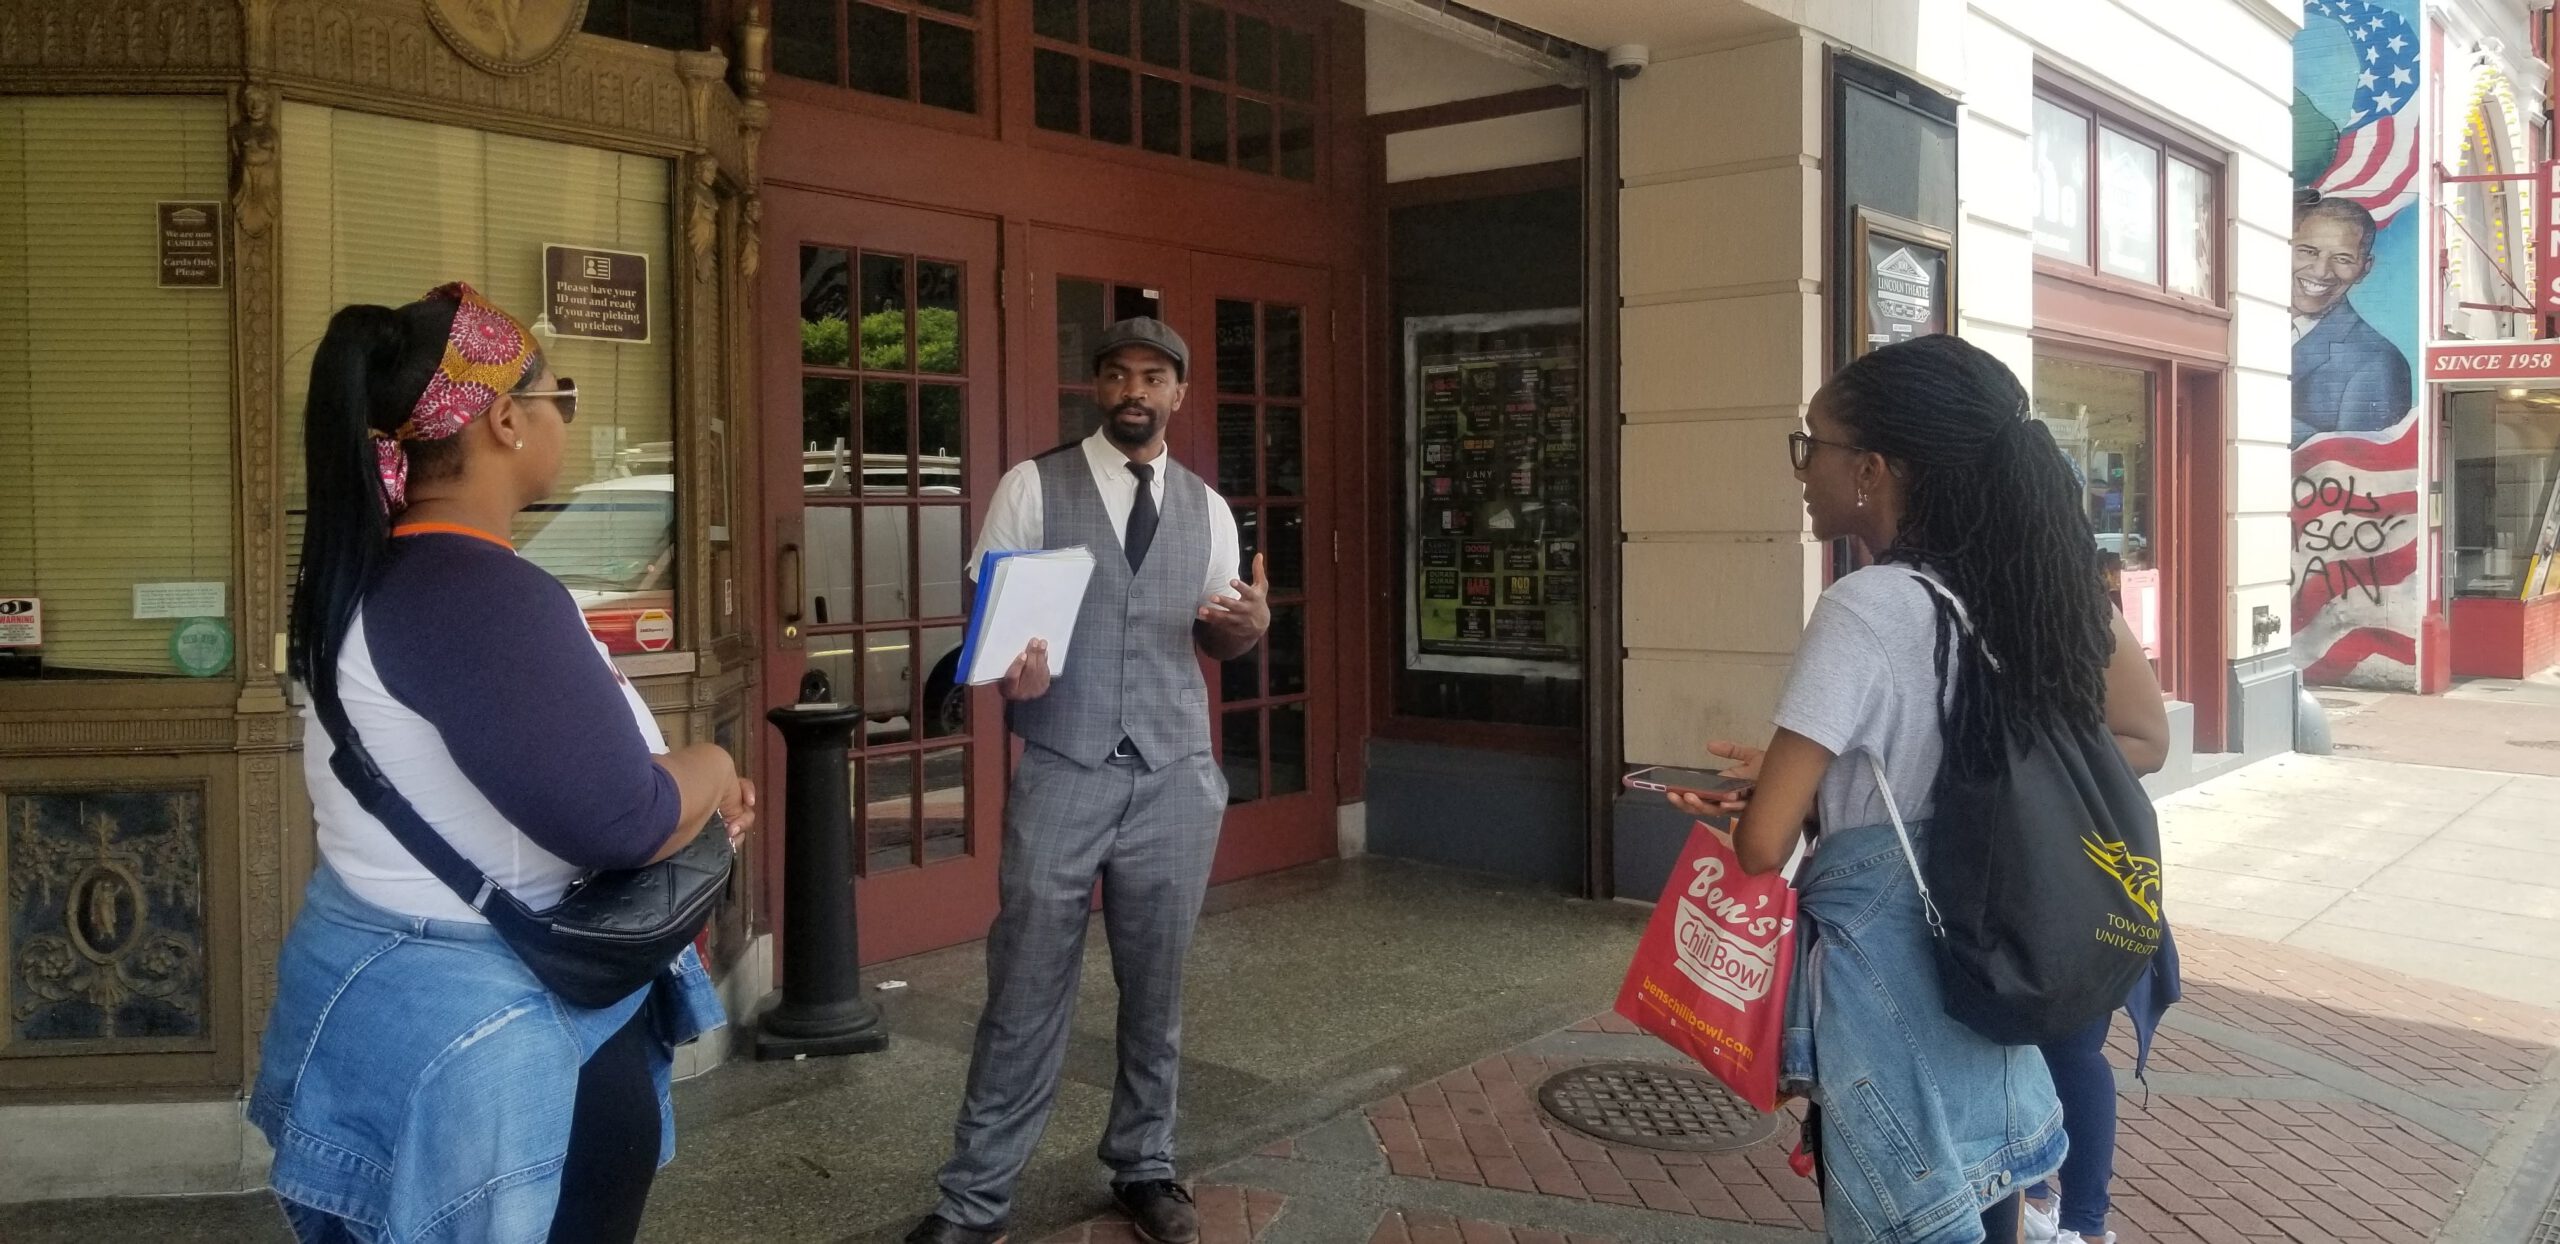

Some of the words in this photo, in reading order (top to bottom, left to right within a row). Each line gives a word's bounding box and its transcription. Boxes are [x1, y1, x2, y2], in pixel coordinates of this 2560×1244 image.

[166, 230, 179, 238] We
[163, 258, 192, 266] Cards
[175, 268, 205, 276] Please
[557, 281, 589, 293] Please
[590, 284, 613, 295] have
[613, 288, 637, 298] your
[1878, 277, 1904, 293] LINCOLN
[1905, 283, 1929, 298] THEATRE
[556, 293, 569, 303] ID
[570, 297, 587, 305] out
[589, 298, 608, 307] and
[609, 300, 636, 311] ready
[555, 305, 564, 315] if
[564, 308, 583, 318] you
[584, 311, 601, 319] are
[602, 310, 641, 324] picking
[574, 322, 588, 332] up
[589, 321, 623, 332] tickets
[2434, 354, 2503, 371] SINCE
[2508, 353, 2553, 369] 1958
[1466, 470, 1493, 479] LANY
[2290, 556, 2384, 607] AN
[1688, 856, 1778, 938] Ben's
[2107, 912, 2161, 940] TOWSON
[1679, 919, 1712, 962] Chili
[1709, 947, 1774, 995] Bowl
[1643, 975, 1754, 1062] benschilibowl.com
